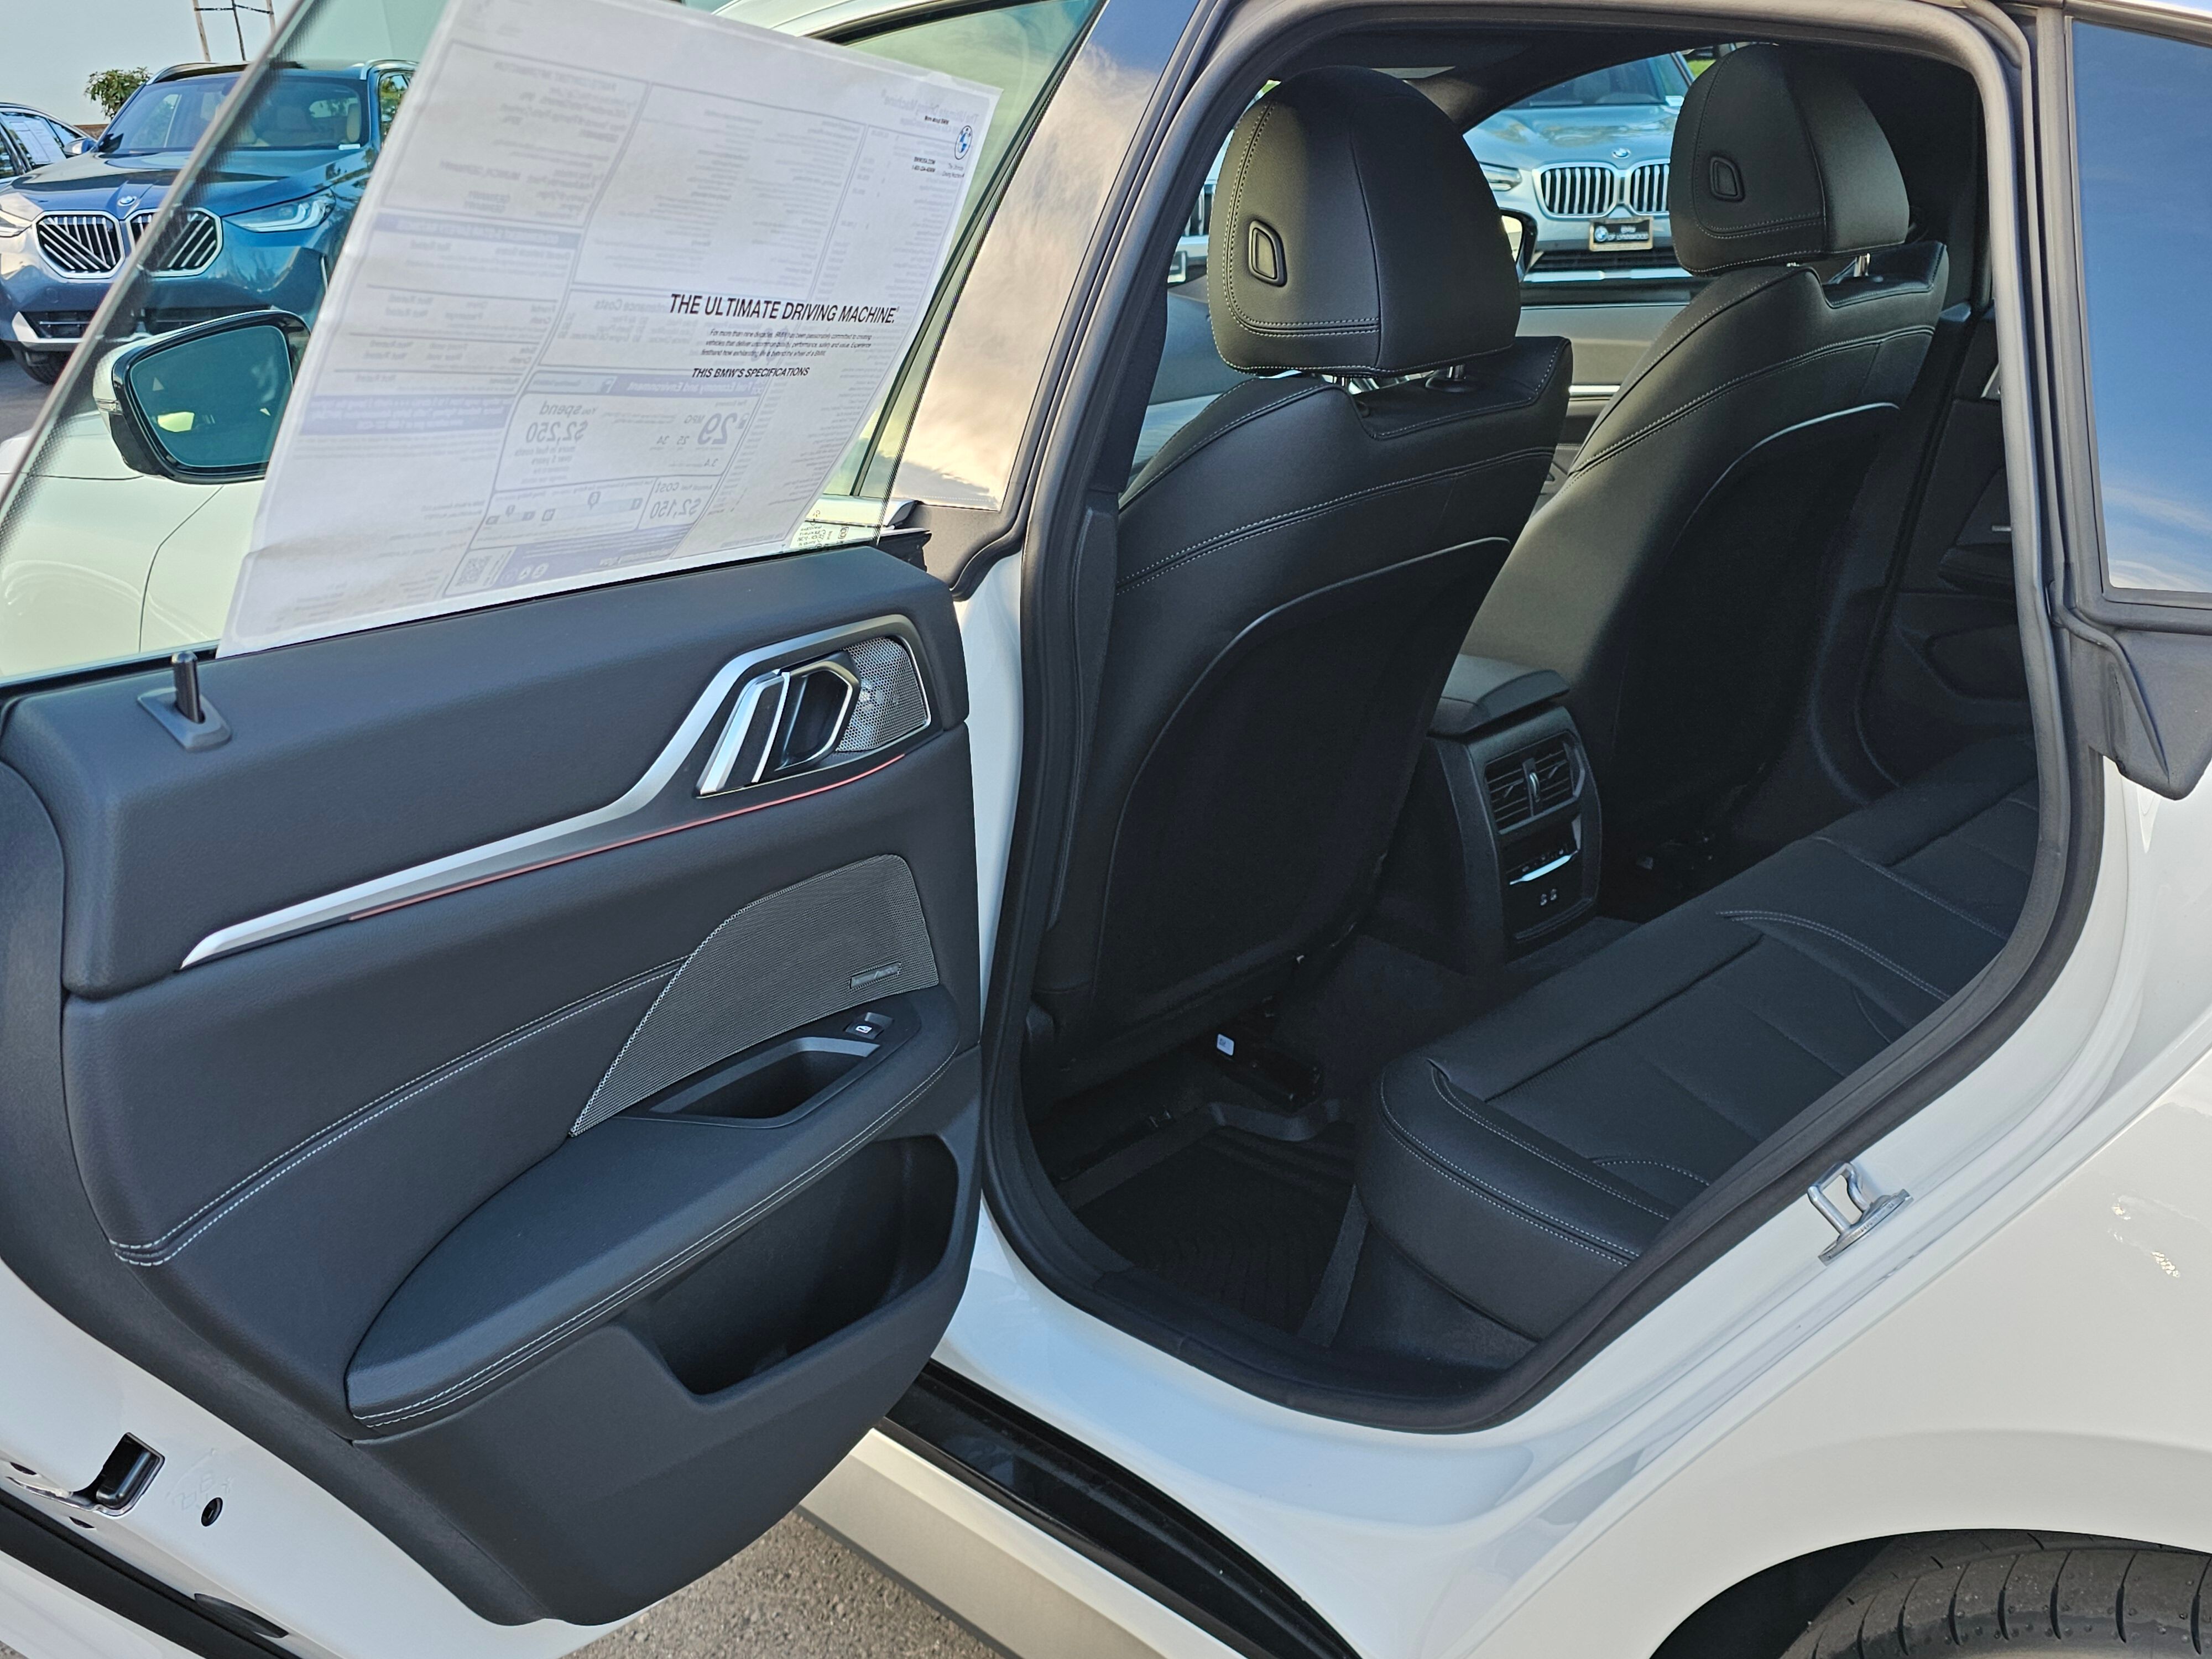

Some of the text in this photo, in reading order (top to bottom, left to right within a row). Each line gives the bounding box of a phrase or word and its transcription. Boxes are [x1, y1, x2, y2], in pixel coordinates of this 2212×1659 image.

[670, 293, 703, 315] THE
[705, 296, 781, 319] ULTIMATE
[781, 302, 838, 322] DRIVING
[692, 367, 810, 378] THIS BMW'S SPECIFICATIONS
